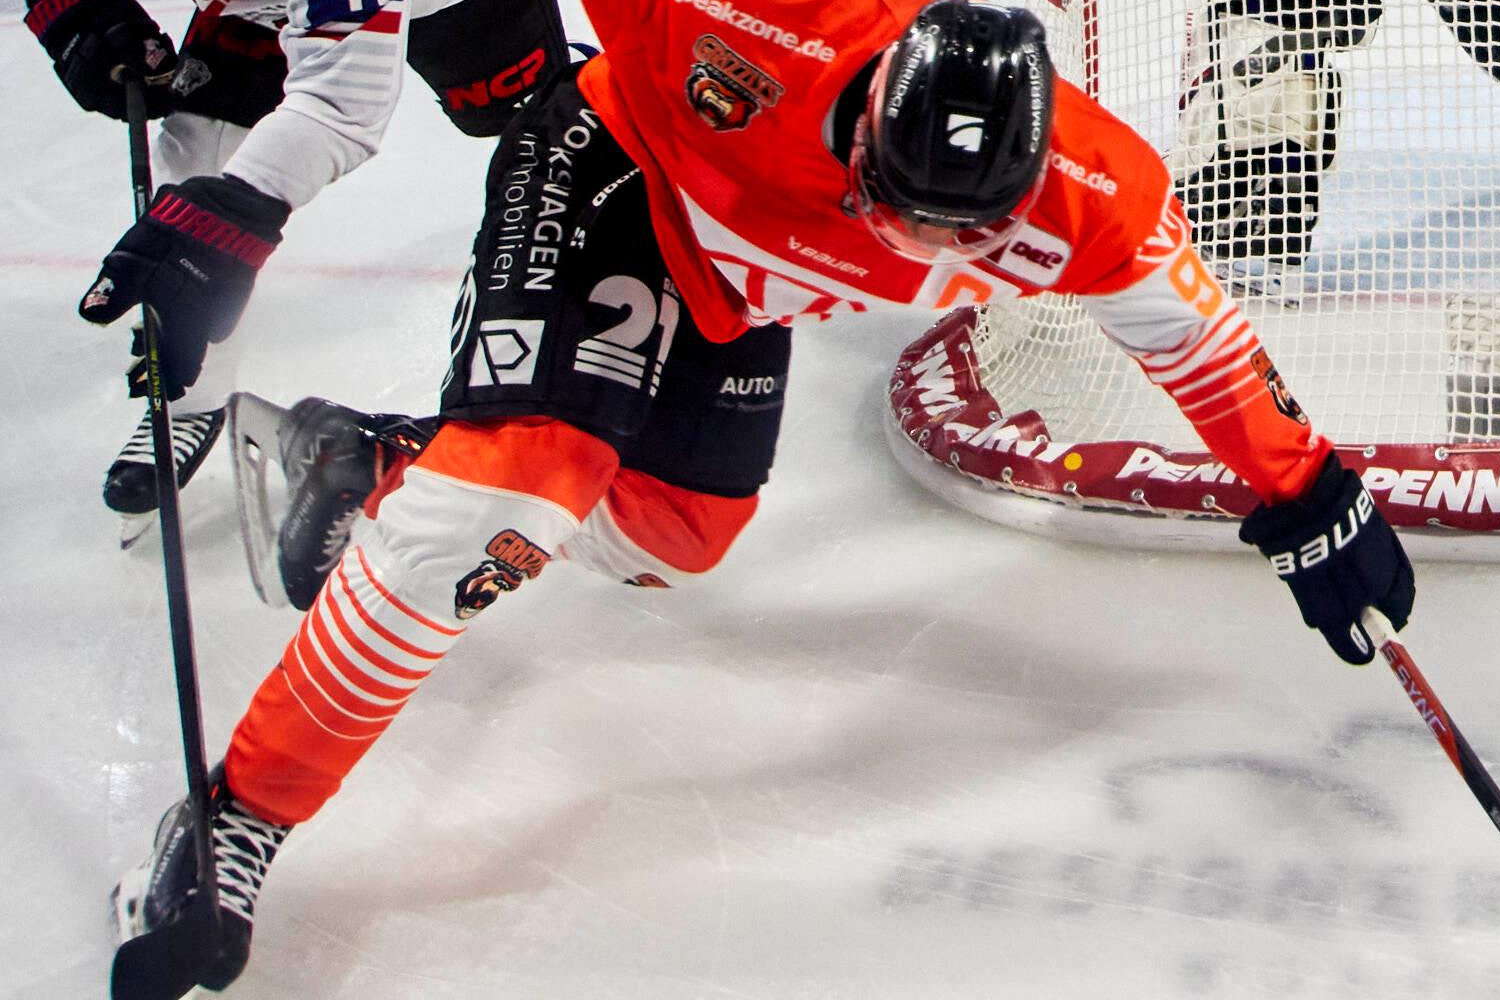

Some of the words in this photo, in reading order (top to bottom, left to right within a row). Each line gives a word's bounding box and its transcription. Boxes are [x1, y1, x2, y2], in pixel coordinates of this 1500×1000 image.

[445, 46, 548, 112] NCP
[802, 244, 871, 278] BAUER
[719, 375, 776, 396] AUTO
